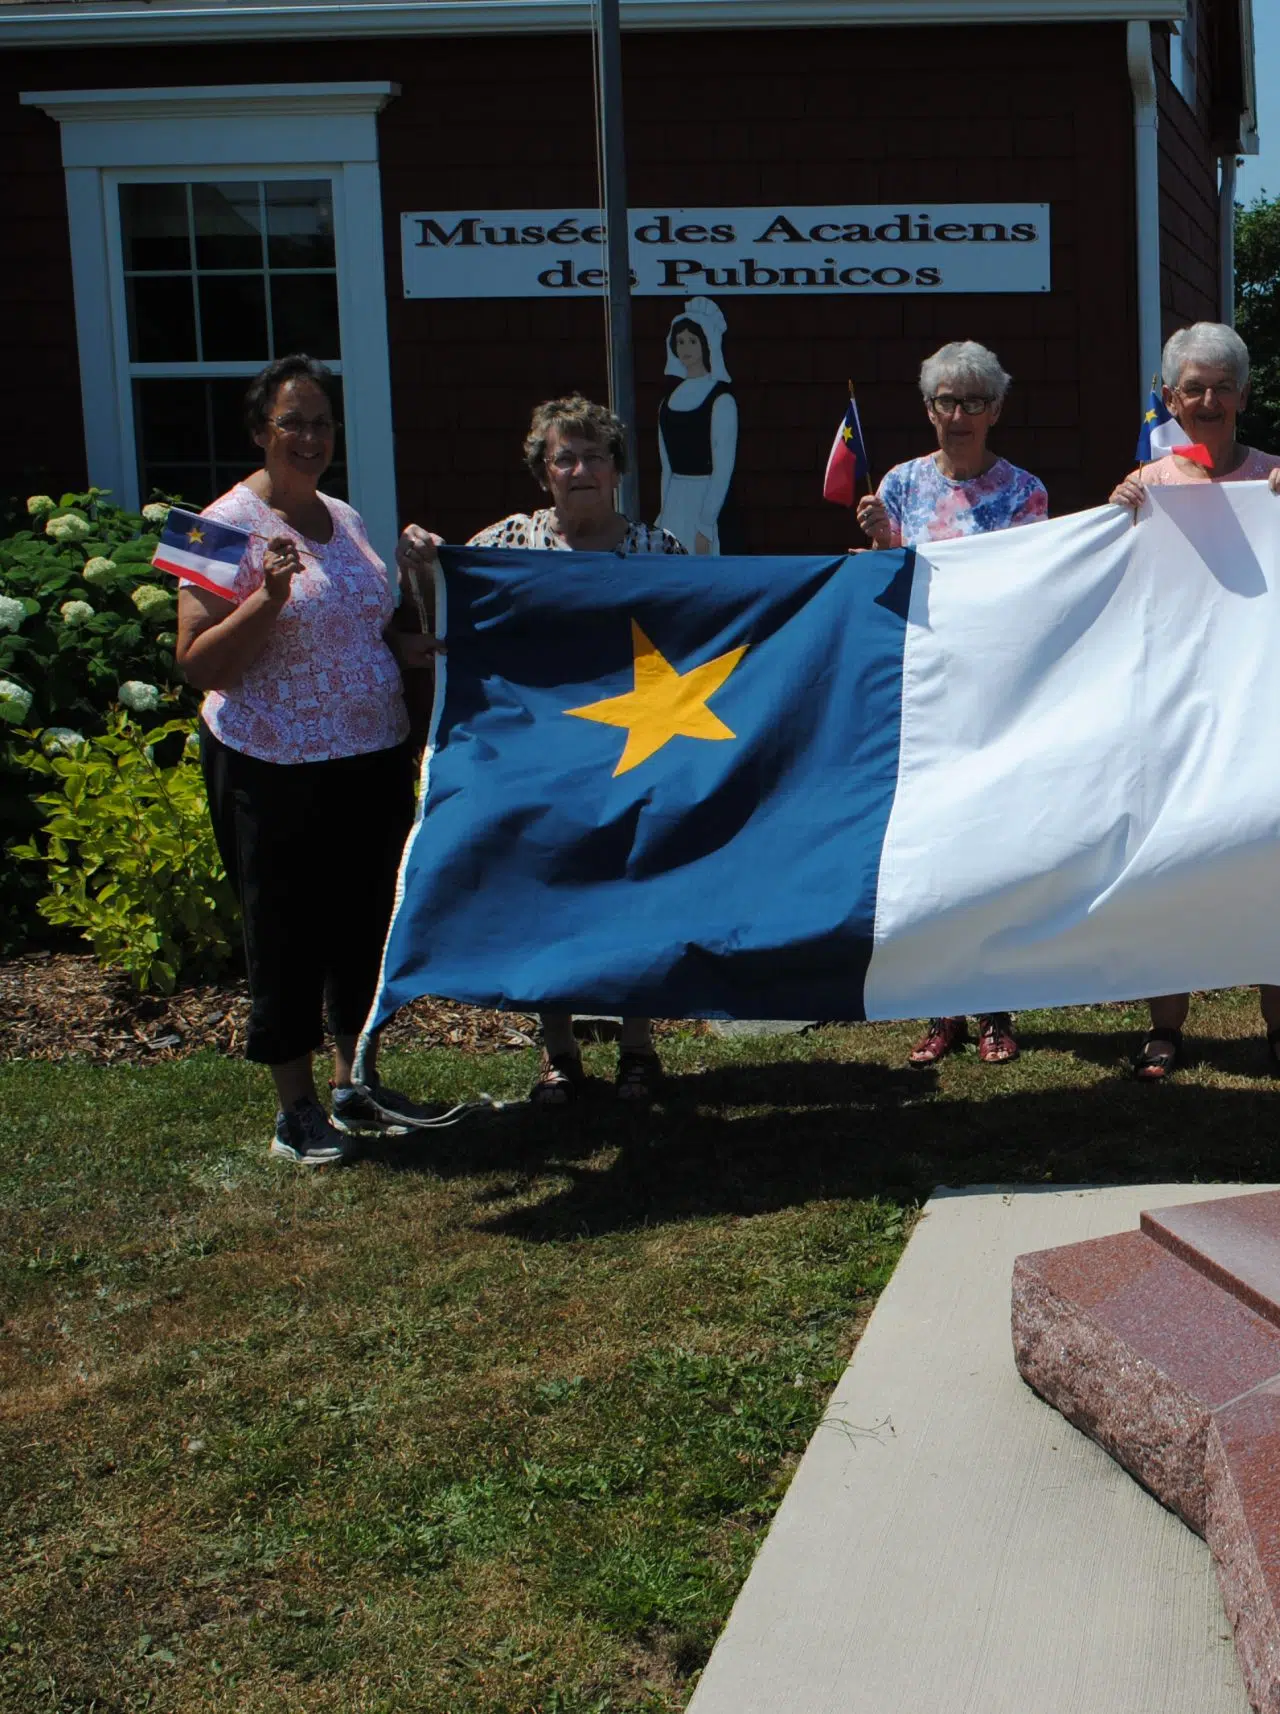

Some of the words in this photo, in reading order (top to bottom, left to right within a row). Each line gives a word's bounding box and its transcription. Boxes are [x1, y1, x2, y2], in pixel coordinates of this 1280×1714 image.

[635, 216, 734, 243] des
[755, 214, 1037, 243] Acadiens
[538, 260, 637, 287] de
[657, 258, 942, 288] Pubnicos
